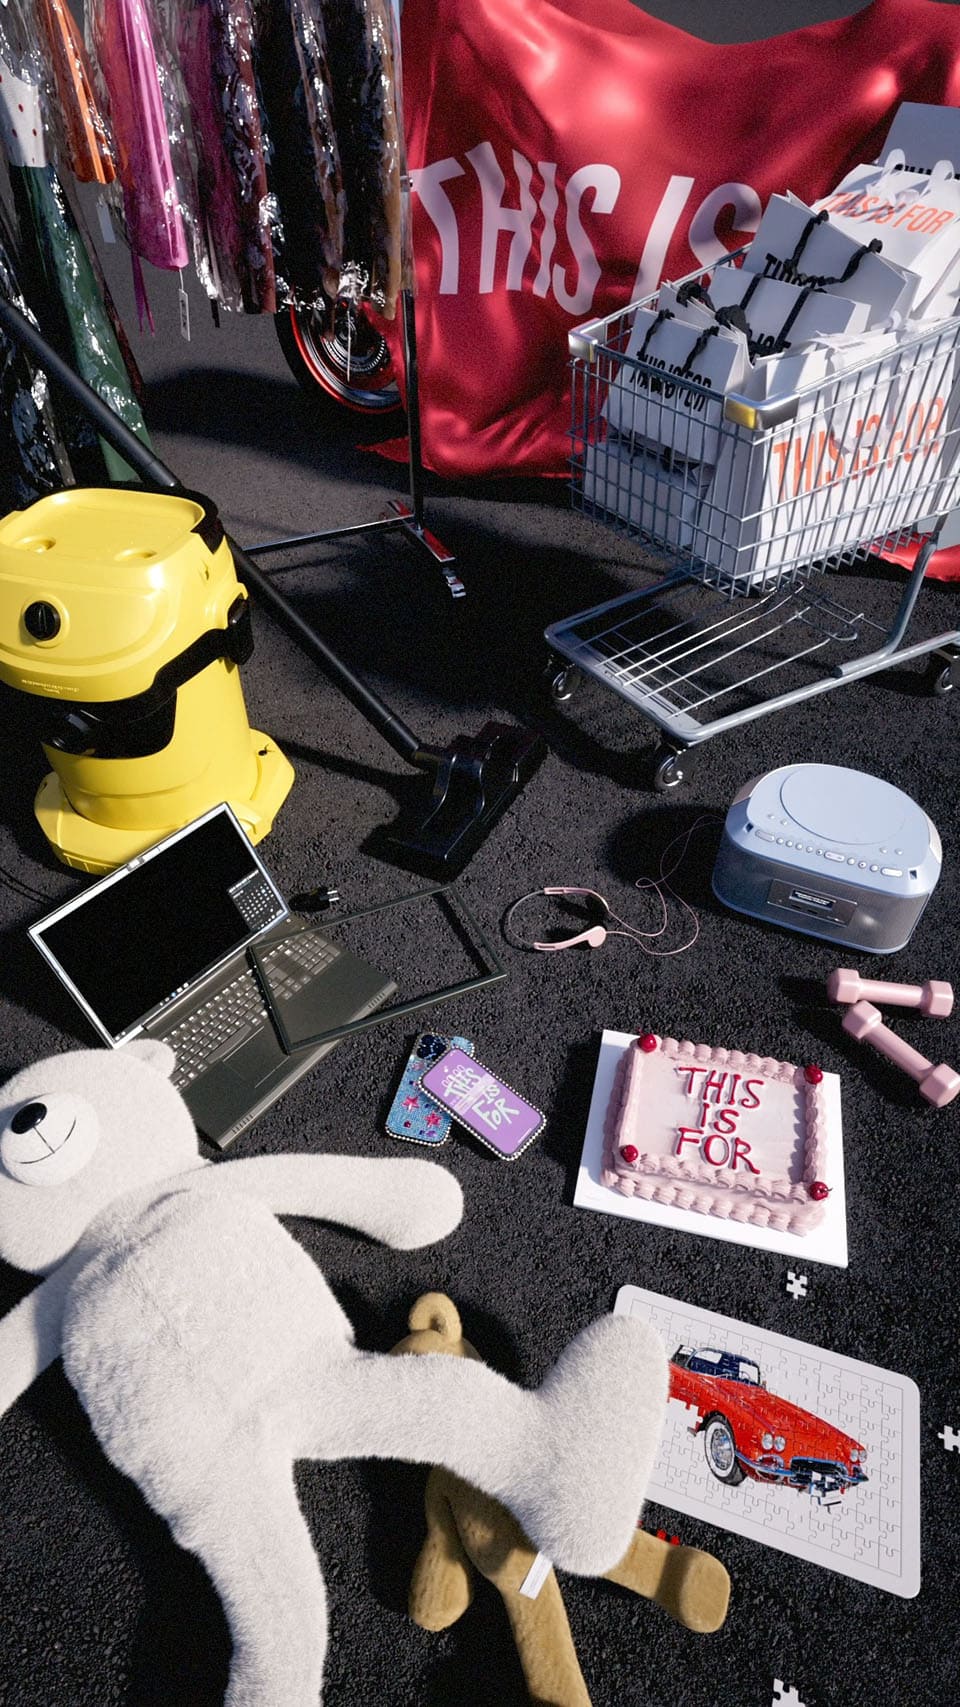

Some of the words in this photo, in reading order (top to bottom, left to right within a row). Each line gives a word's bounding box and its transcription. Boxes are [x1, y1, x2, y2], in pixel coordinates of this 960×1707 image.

[408, 141, 621, 316] THIS
[819, 192, 880, 219] THIS
[892, 203, 955, 235] FOR
[773, 428, 845, 503] THIS
[482, 1084, 501, 1105] IS
[678, 1066, 765, 1109] THIS
[700, 1102, 740, 1134] IS
[676, 1126, 761, 1175] FOR
